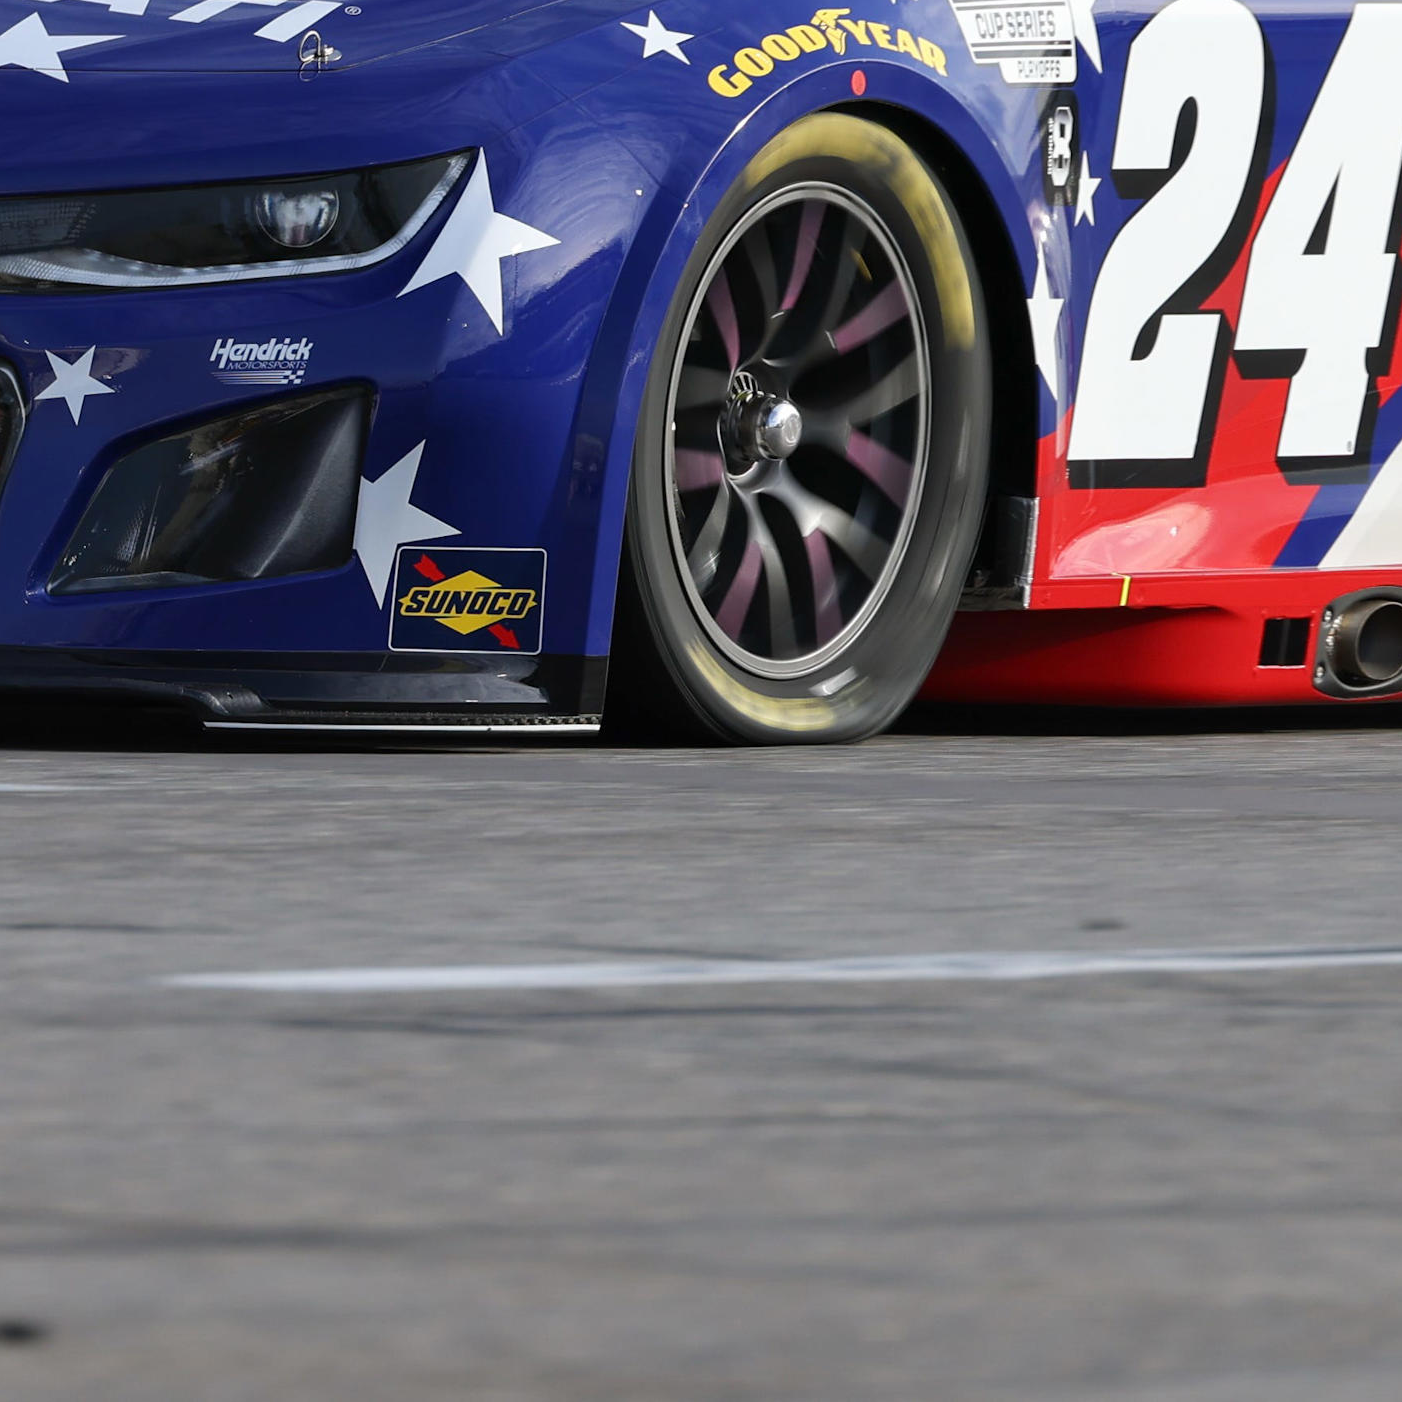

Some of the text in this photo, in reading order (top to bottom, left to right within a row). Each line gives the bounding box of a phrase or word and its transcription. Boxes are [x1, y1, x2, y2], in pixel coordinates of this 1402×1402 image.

[975, 10, 1056, 39] CUP SERIES
[708, 13, 948, 97] GOODYEAR
[1052, 106, 1074, 186] 8
[209, 338, 314, 369] Hendrick
[225, 361, 308, 370] MOTORSPORTS
[404, 589, 532, 617] SUNOCO
